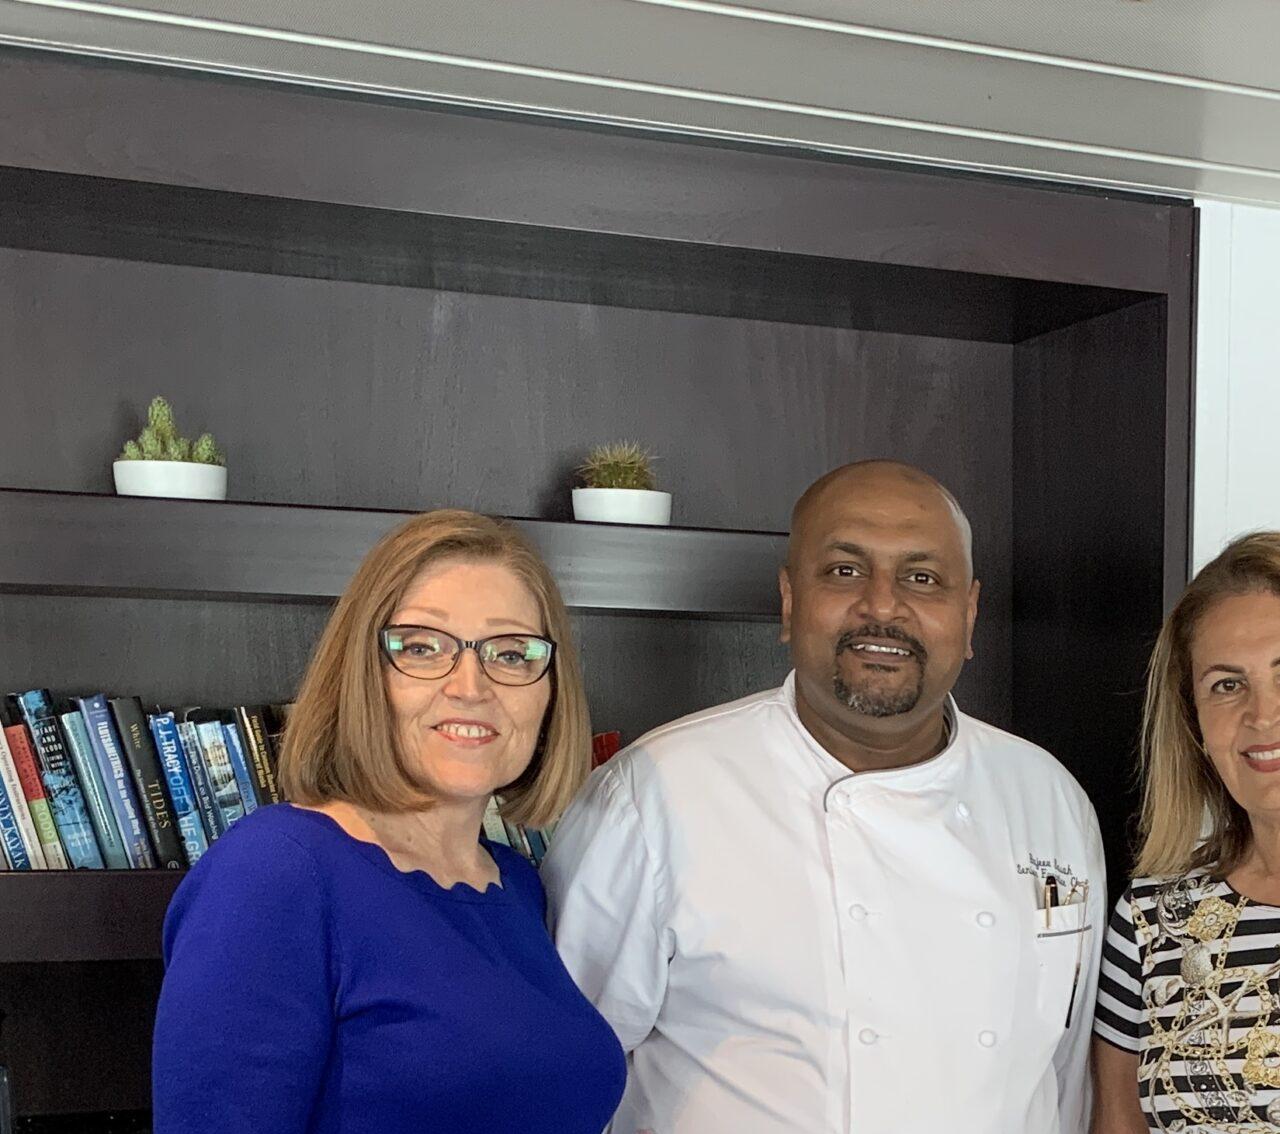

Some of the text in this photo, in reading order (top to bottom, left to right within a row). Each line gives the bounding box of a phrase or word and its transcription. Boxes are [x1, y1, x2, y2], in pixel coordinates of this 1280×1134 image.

[129, 723, 144, 750] White
[155, 716, 182, 775] P. J. TRACY
[147, 779, 171, 830] TIDES
[169, 774, 189, 805] OFF
[201, 796, 212, 810] Bird
[176, 807, 198, 838] THE
[204, 810, 220, 840] Watching
[4, 826, 25, 868] KAYAK
